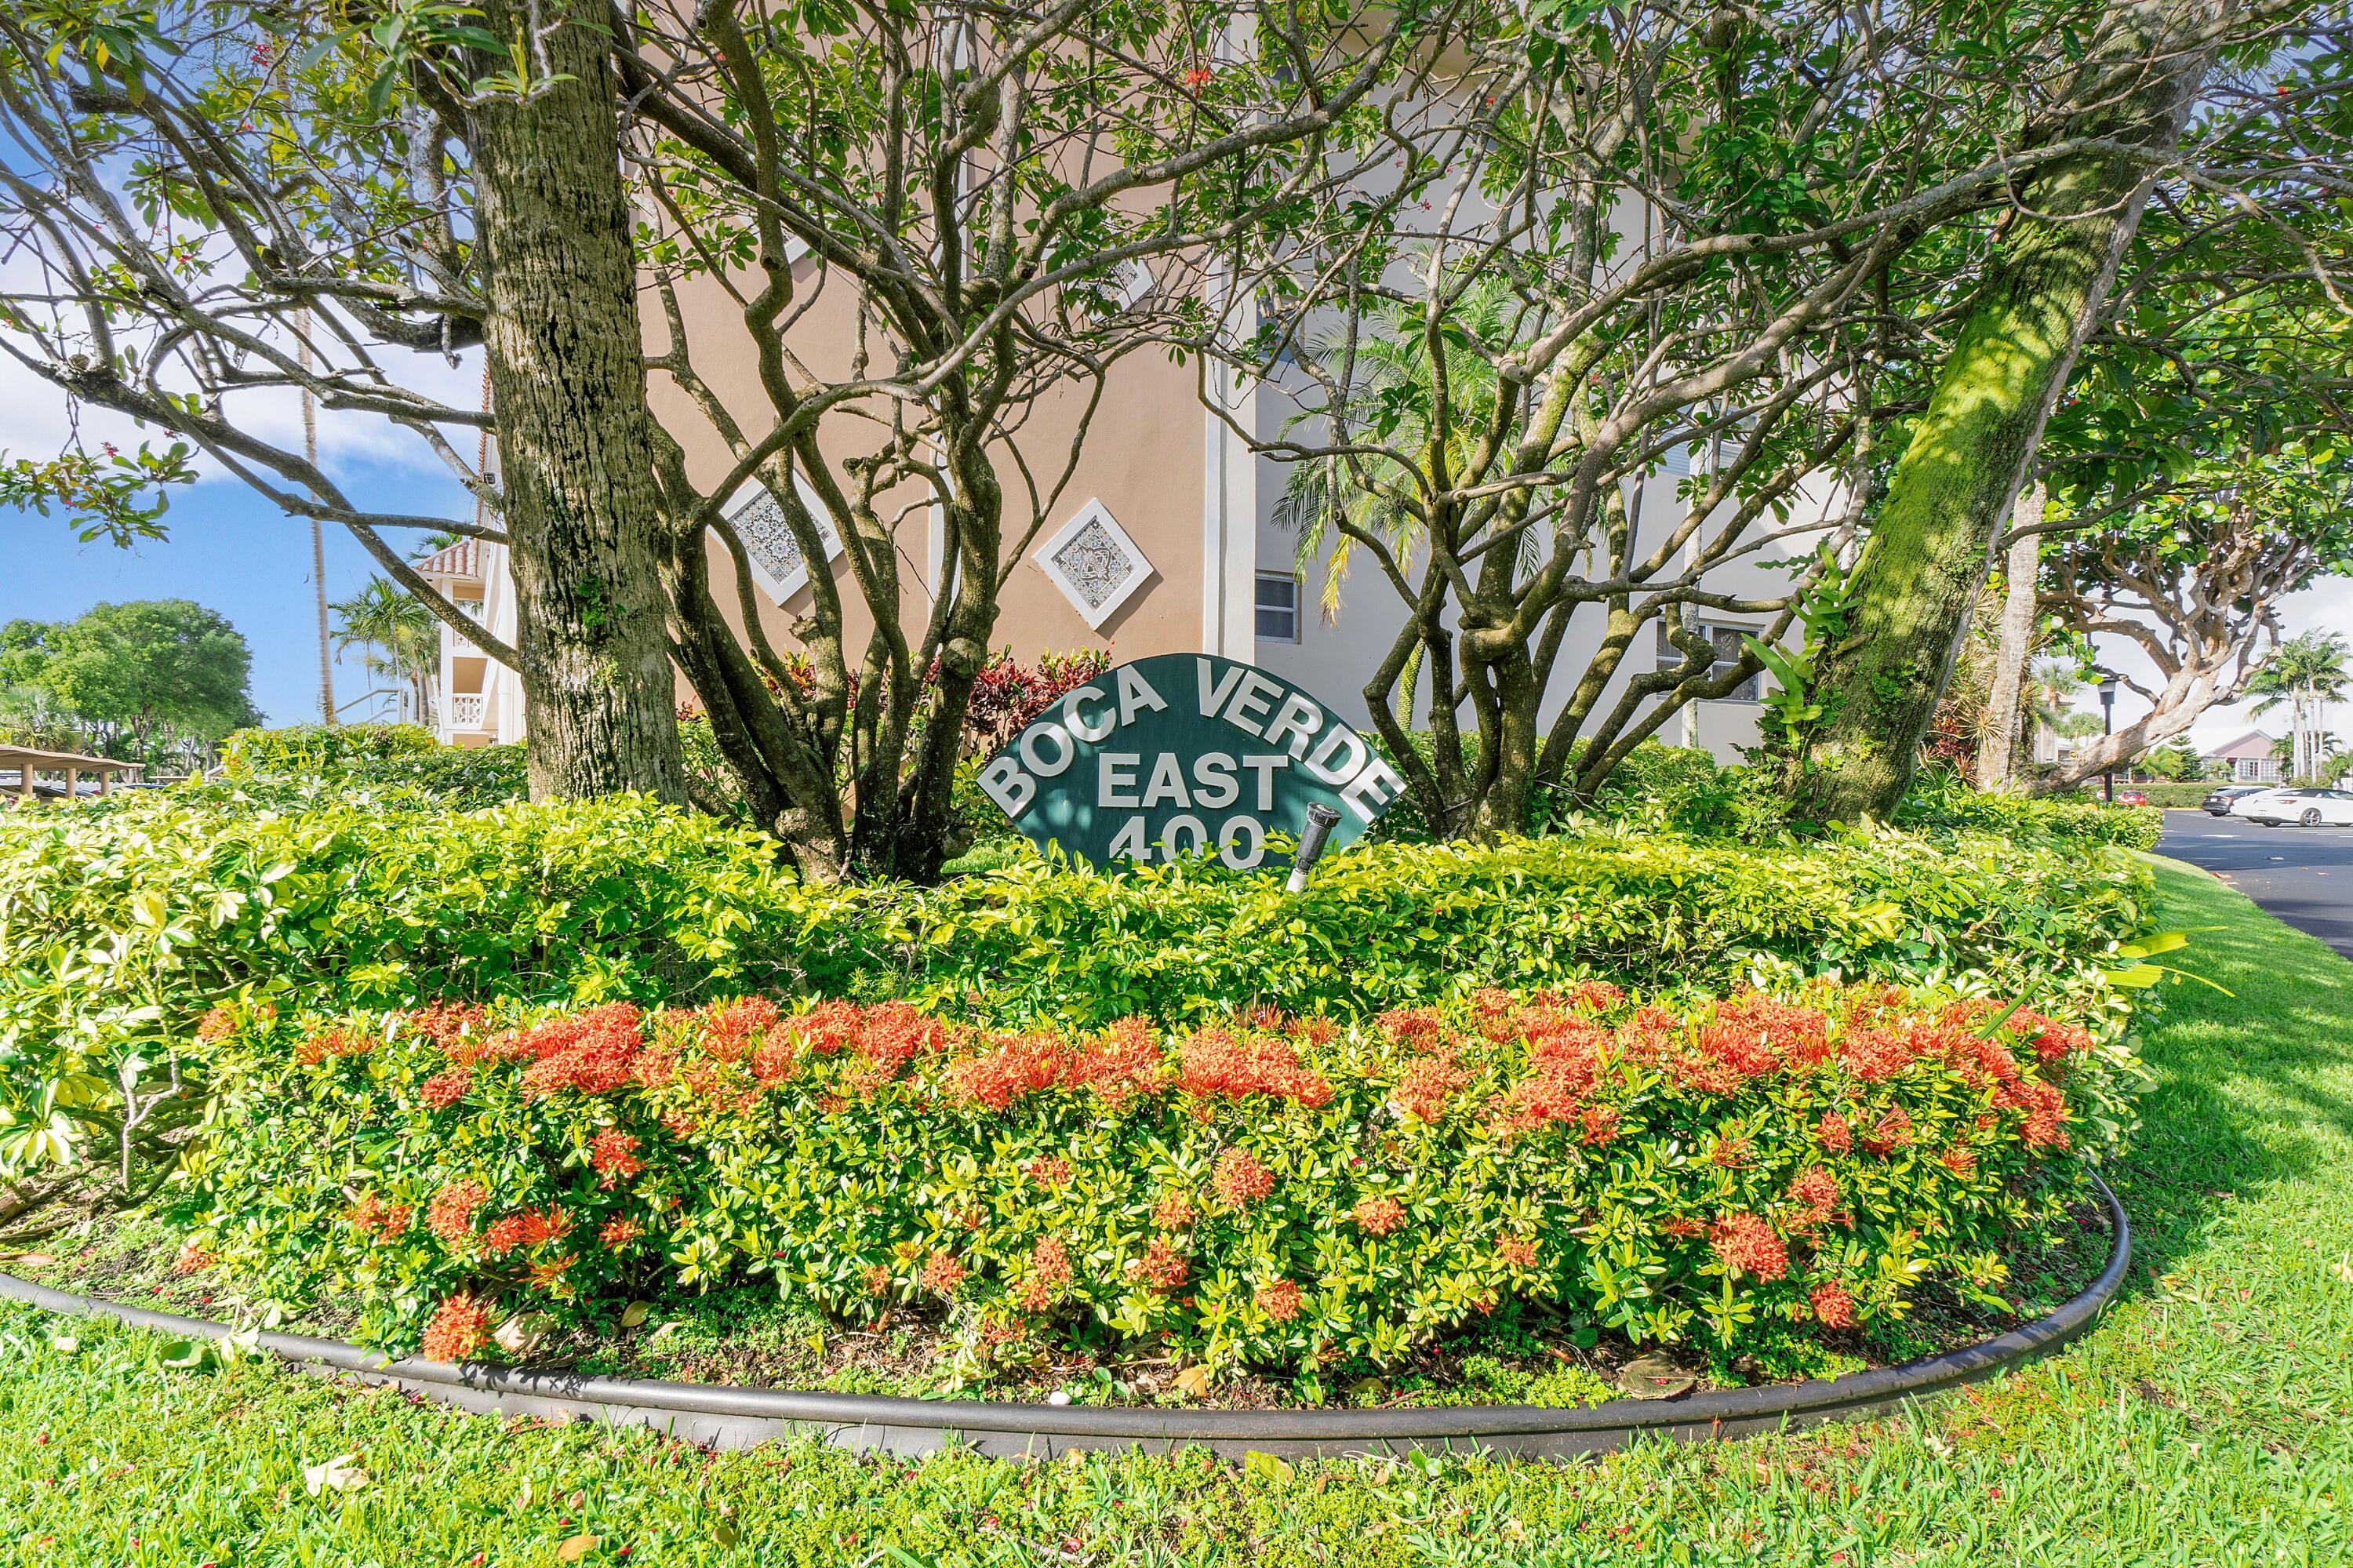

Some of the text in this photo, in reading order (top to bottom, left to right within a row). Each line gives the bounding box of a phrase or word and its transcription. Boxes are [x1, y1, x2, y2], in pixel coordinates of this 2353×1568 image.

[976, 657, 1407, 824] BOCA VERDE
[1098, 752, 1289, 810] EAST
[1108, 815, 1265, 870] 400
